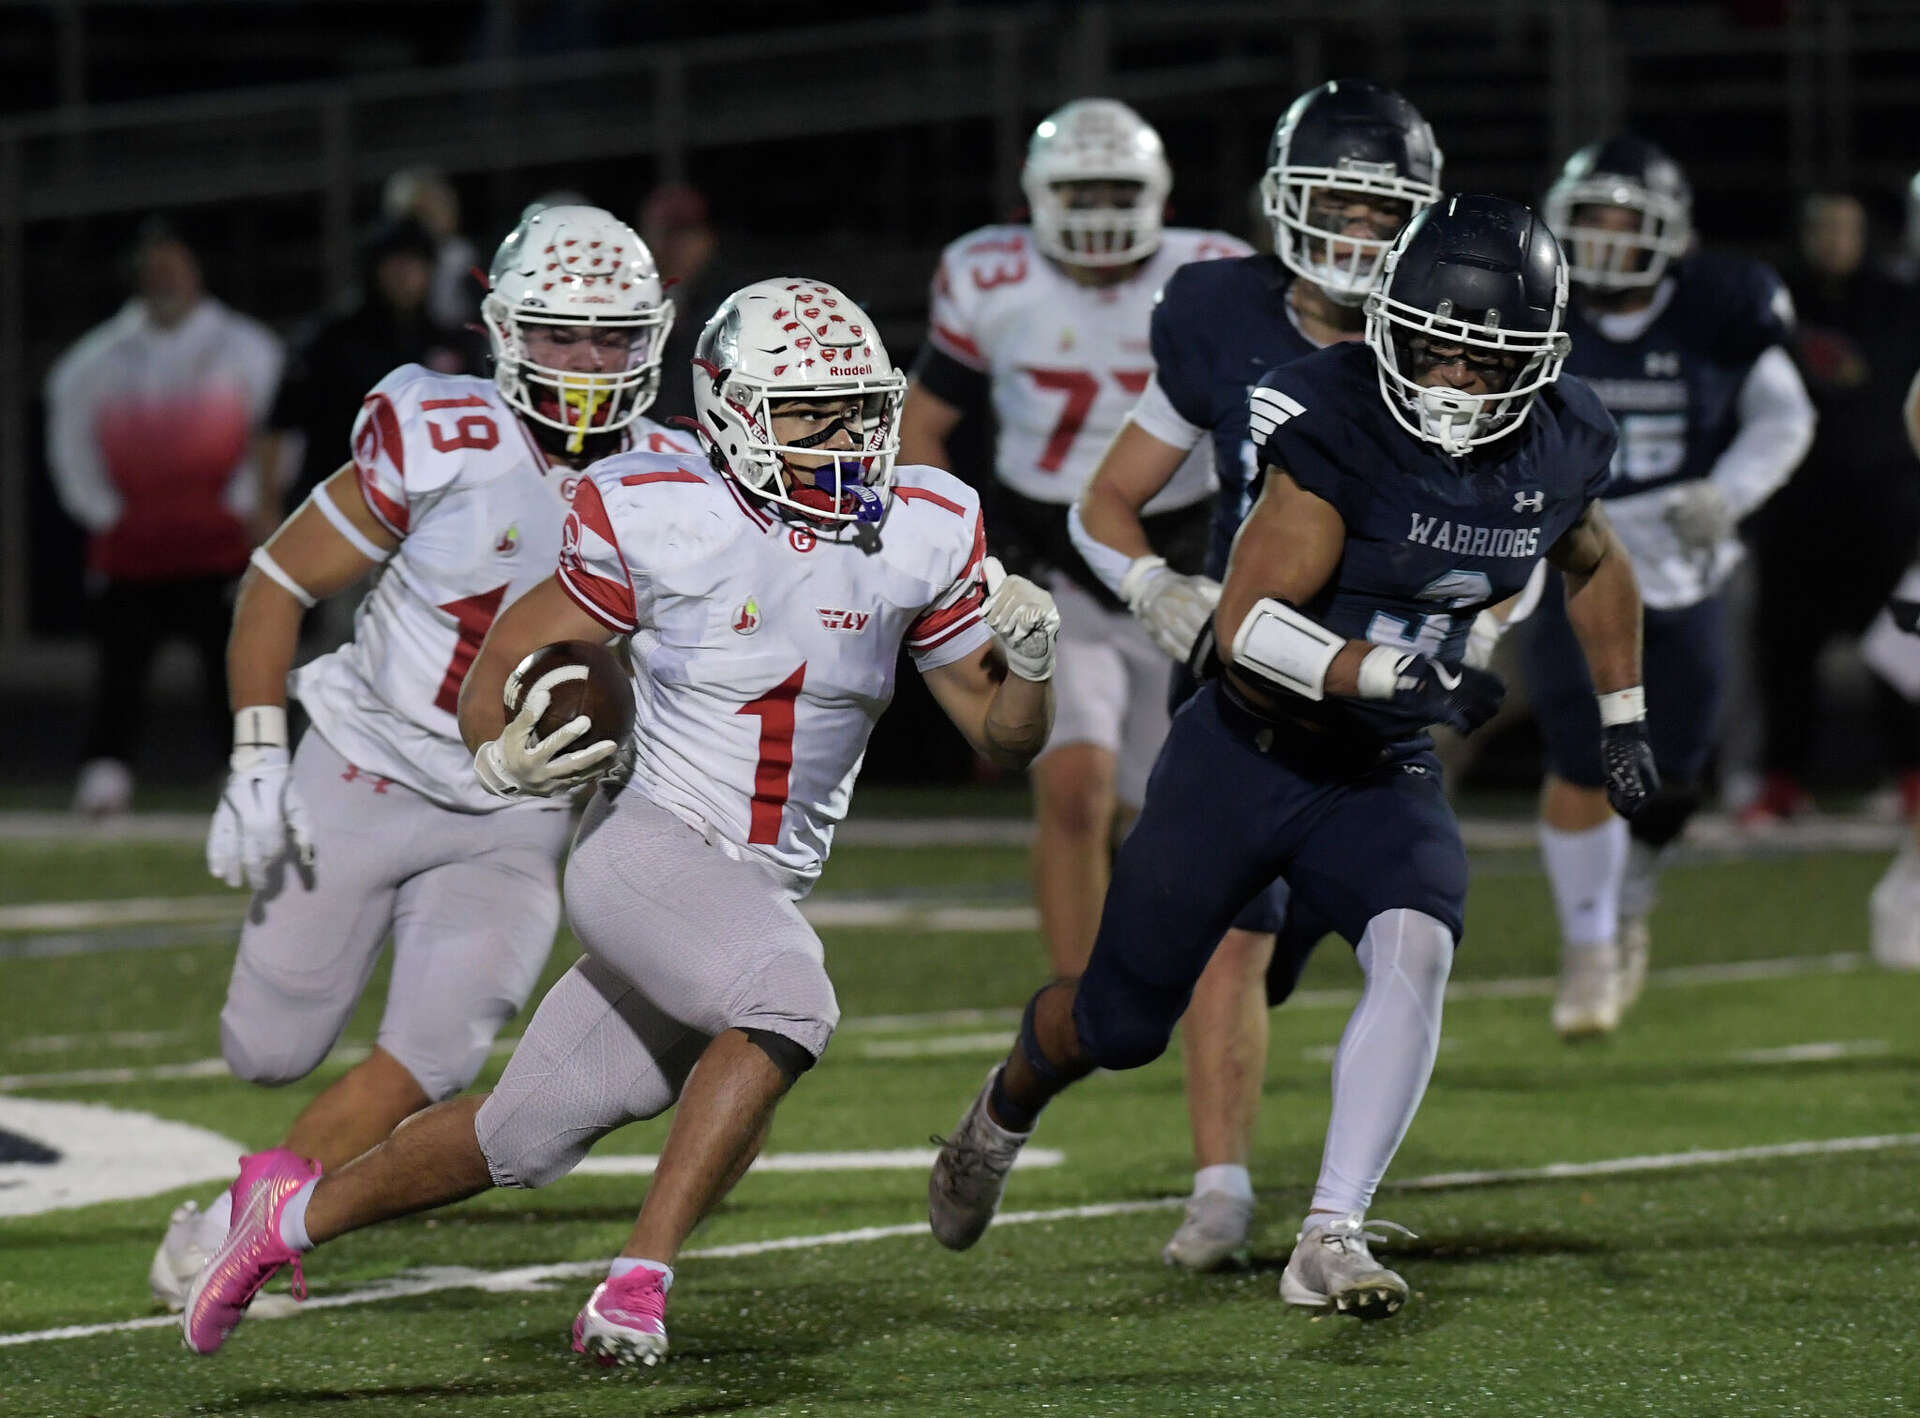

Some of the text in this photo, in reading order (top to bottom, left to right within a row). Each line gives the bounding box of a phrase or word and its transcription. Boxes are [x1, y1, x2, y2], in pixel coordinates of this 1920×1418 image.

[830, 364, 873, 377] Riddell
[421, 394, 500, 453] 19
[1027, 367, 1150, 472] 7
[620, 467, 709, 487] 1
[890, 486, 966, 518] 1
[1408, 513, 1541, 558] WARRIORS
[734, 660, 807, 844] 1
